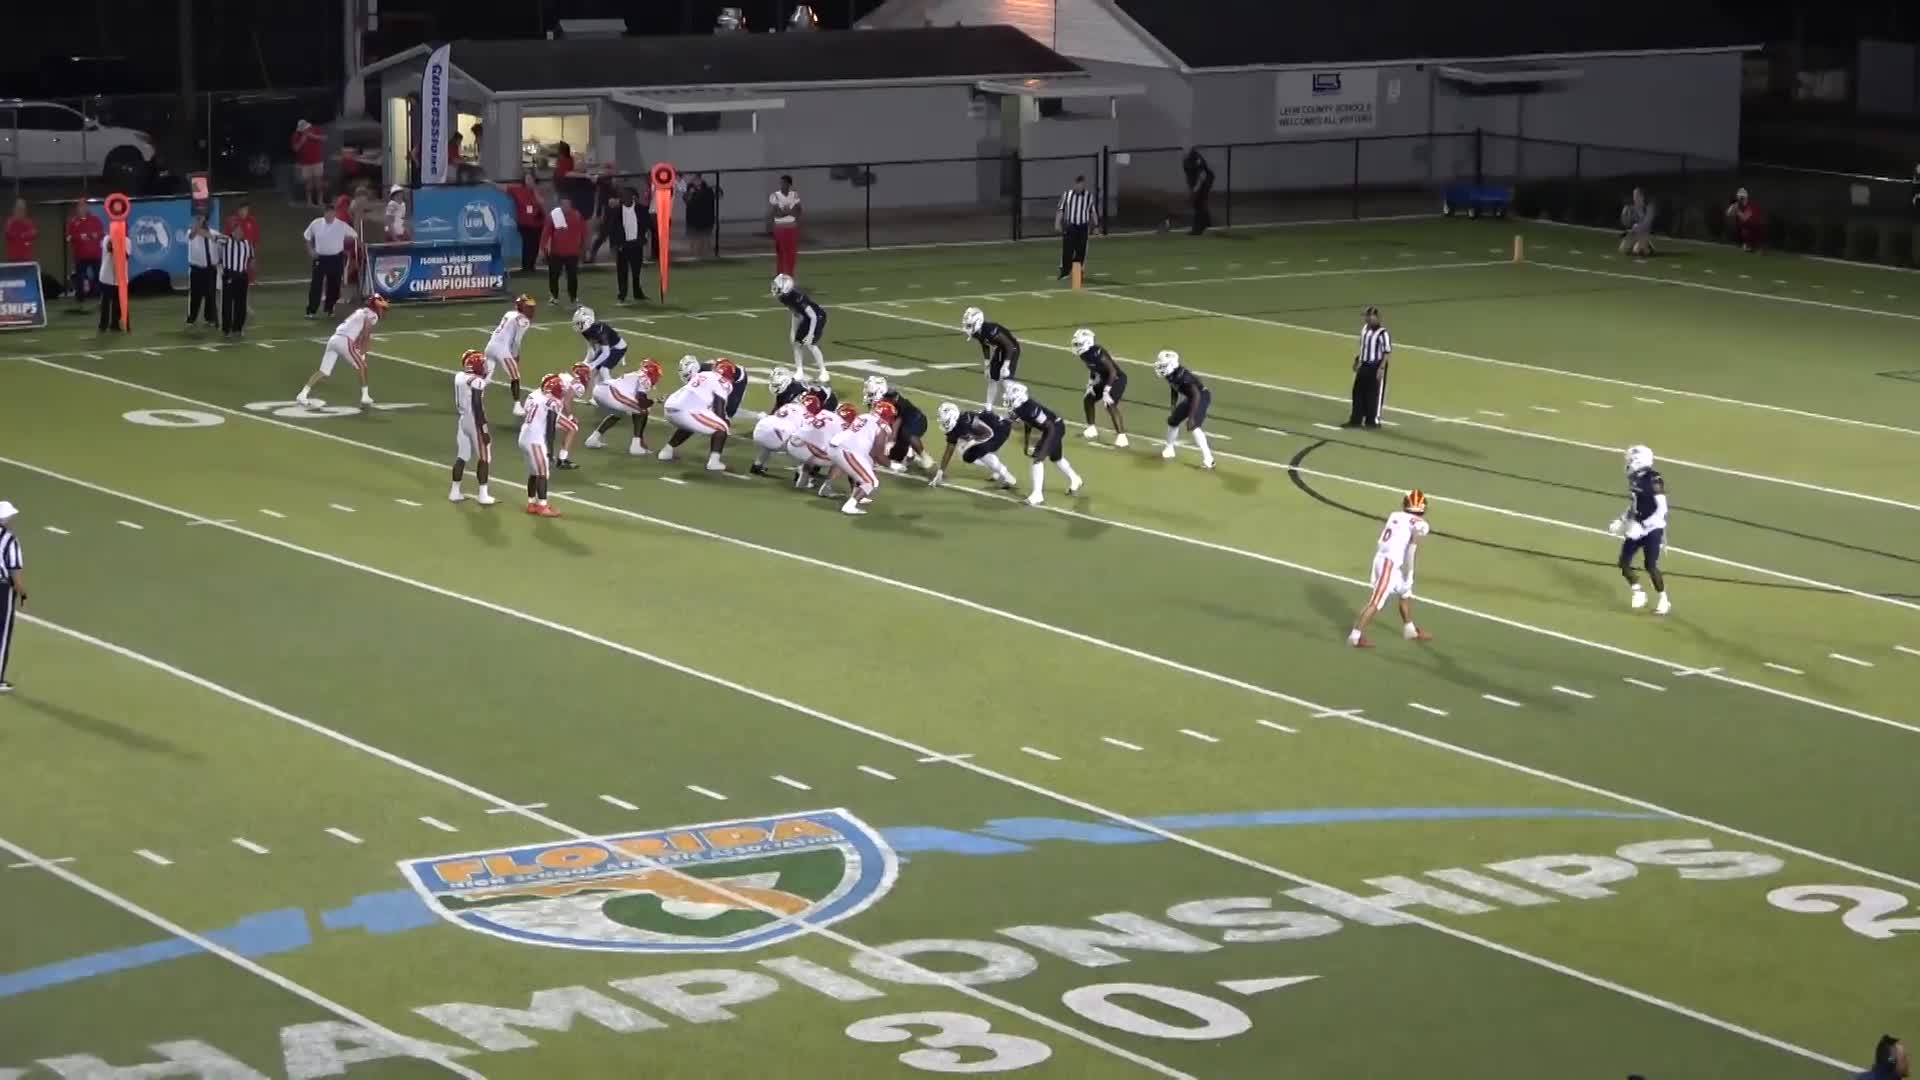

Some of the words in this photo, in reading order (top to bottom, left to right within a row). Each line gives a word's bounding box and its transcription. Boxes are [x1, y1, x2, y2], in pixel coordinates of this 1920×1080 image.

[420, 256, 448, 266] FLORIDA
[450, 255, 467, 264] HIGH
[468, 254, 492, 263] SCHOOL
[441, 263, 473, 276] STATE
[409, 275, 503, 292] CHAMPIONSHIPS
[432, 819, 842, 882] FLORIDA
[844, 981, 1251, 1073] 30
